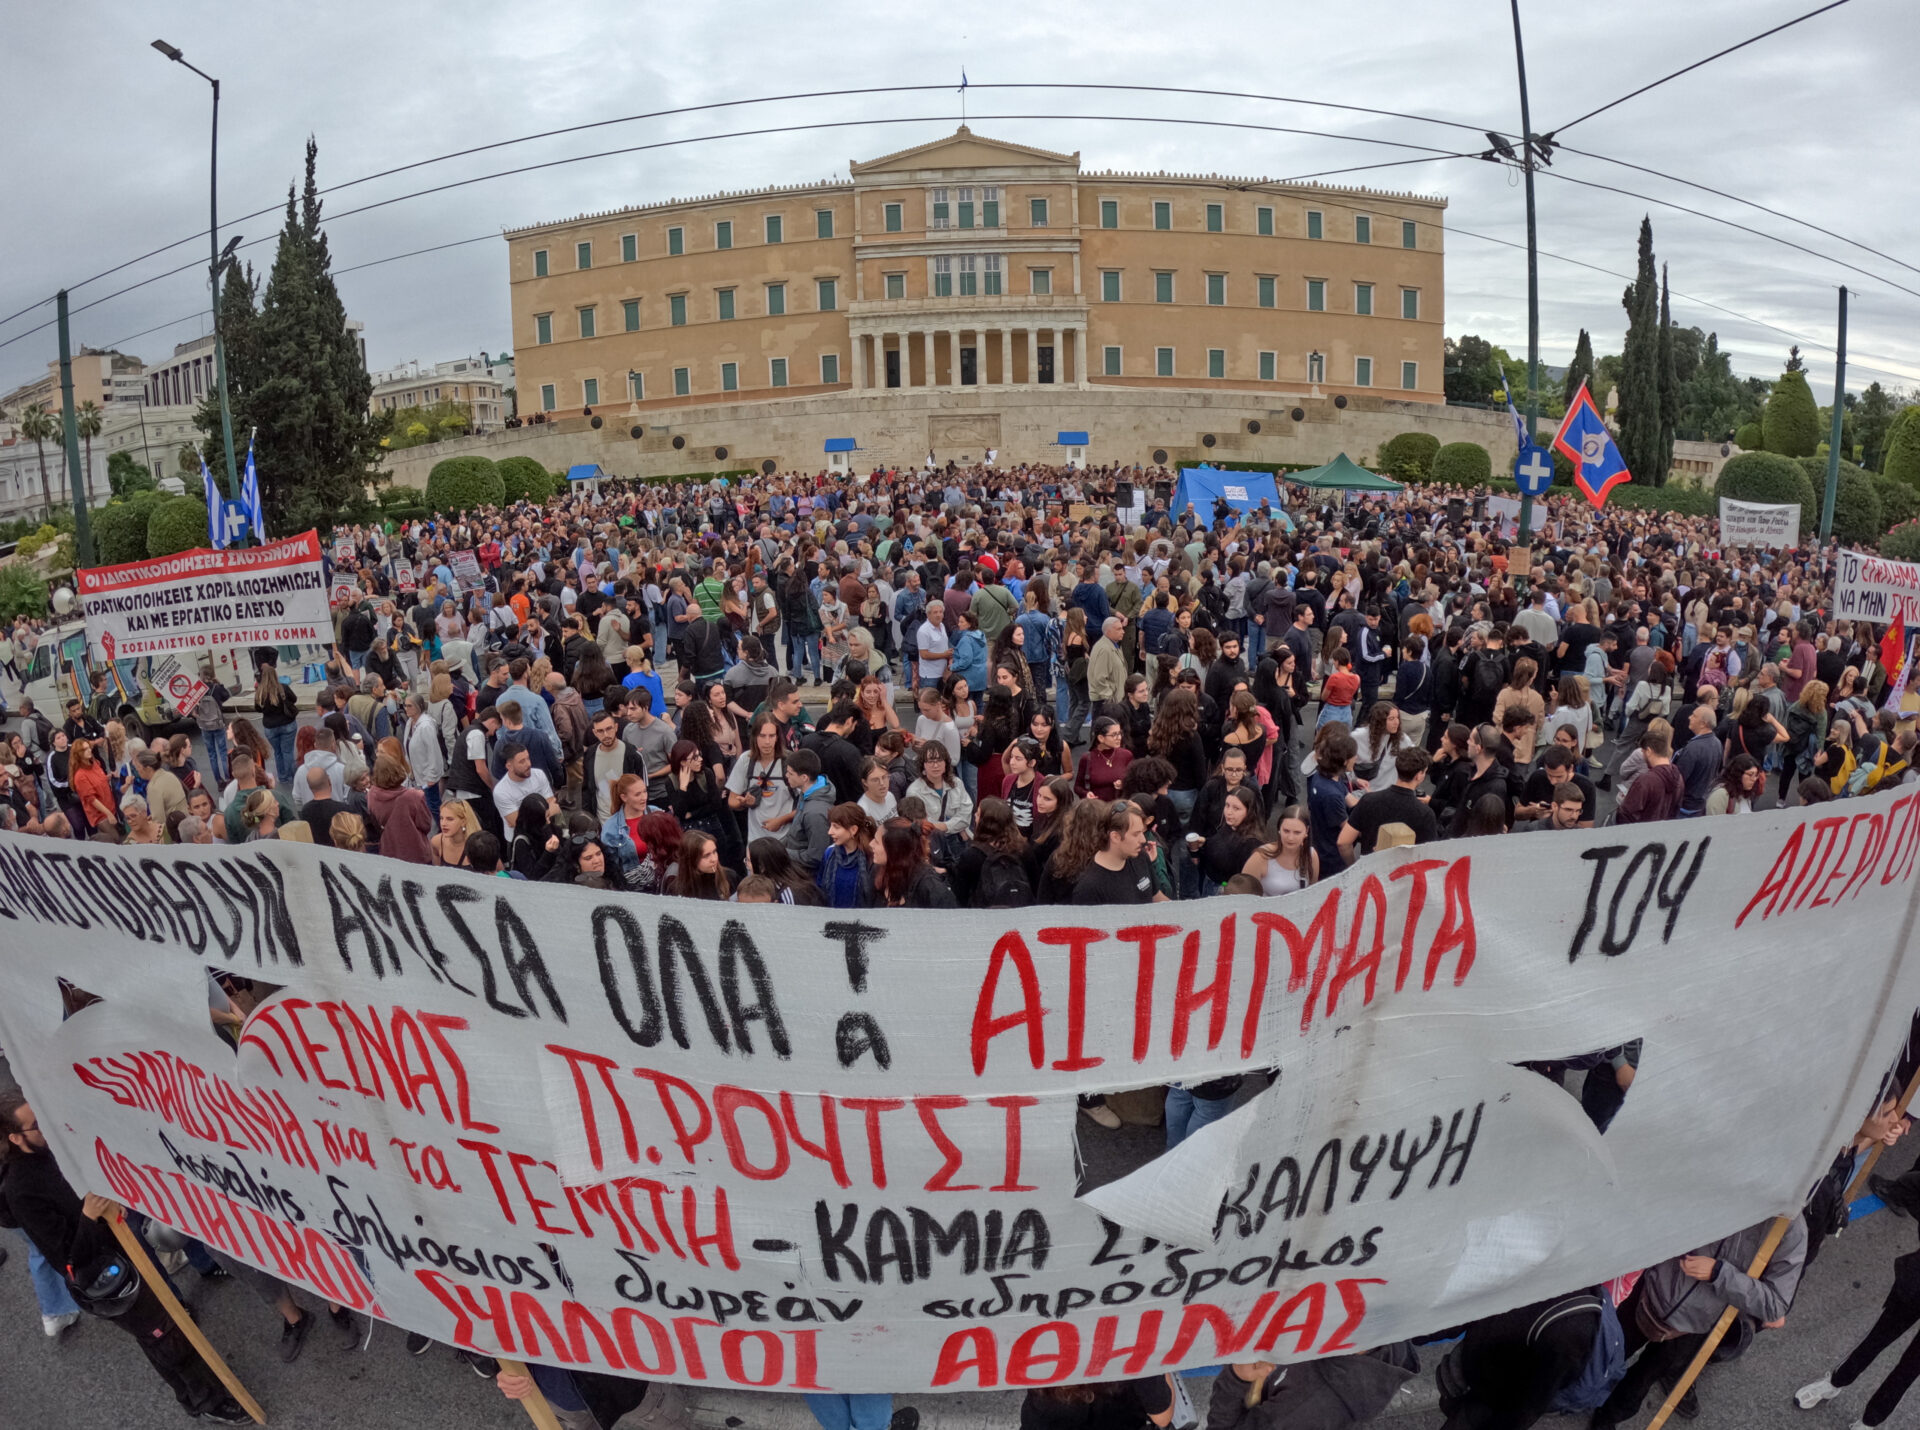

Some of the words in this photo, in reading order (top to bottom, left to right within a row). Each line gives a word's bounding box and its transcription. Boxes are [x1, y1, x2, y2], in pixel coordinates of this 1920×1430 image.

[85, 573, 100, 588] ΟΙ
[102, 553, 224, 586] ΙΔΙΩΤΙΚΟΠΟΙΗΣΕΙΣ
[227, 540, 310, 567] ΣΚΟΤΩΝΟΥΝ
[1842, 554, 1858, 583] ΤΟ
[85, 586, 193, 616] ΚΡΑΤΙΚΟΠΟΙΗΣΕΙΣ
[195, 581, 236, 601] ΧΩΡΙΣ
[236, 570, 322, 598] ΑΠΟΖΗΜΙΩΣΗ
[127, 615, 149, 632] ΚΑΙ
[150, 611, 169, 629] ΜΕ
[172, 603, 232, 627] ΕΡΓΑΤΙΚΟ
[235, 600, 285, 619] ΕΛΕΓΧΟ
[1840, 589, 1855, 613] ΝΑ
[1858, 590, 1887, 617] ΜΗΝ
[1890, 593, 1920, 622] ΣΥΓΚ
[121, 635, 206, 654] ΣΟΣΙΑΛΙΣΤΙΚΟ
[211, 629, 270, 644] ΕΡΓΑΤΙΚΟ
[274, 626, 317, 641] ΚΟΜΜΑ
[319, 860, 569, 1028] ΑΜΕΣΑ
[592, 904, 793, 1060] ΟΛΑ
[970, 855, 1478, 1077] ΑΙΤΗΜΑΤΑ
[1568, 835, 1712, 965] ΤΟΥ
[238, 998, 501, 1135] ΠΕΙΝΑΣ
[72, 1050, 320, 1175] ΔΙΚΑΙΟΣΥΝΗ
[312, 1119, 378, 1170] για
[389, 1137, 463, 1194] τα
[456, 1137, 742, 1272] ΤΕΜΠΗ
[815, 1200, 1051, 1285] ΚΑΜΙΑ
[158, 1128, 306, 1228] Ασφαλής
[325, 1174, 552, 1291] δημόσιος
[613, 1247, 864, 1324] δωρεάν
[922, 1225, 1384, 1320] σιδηρόδρομος
[94, 1135, 391, 1320] ΦΟΙΤΗΤΙΚΟΙ
[415, 1268, 834, 1391] ΣΥΛΛΟΓΟΙ
[930, 1277, 1389, 1389] ΑΘΗΝΑΣ
